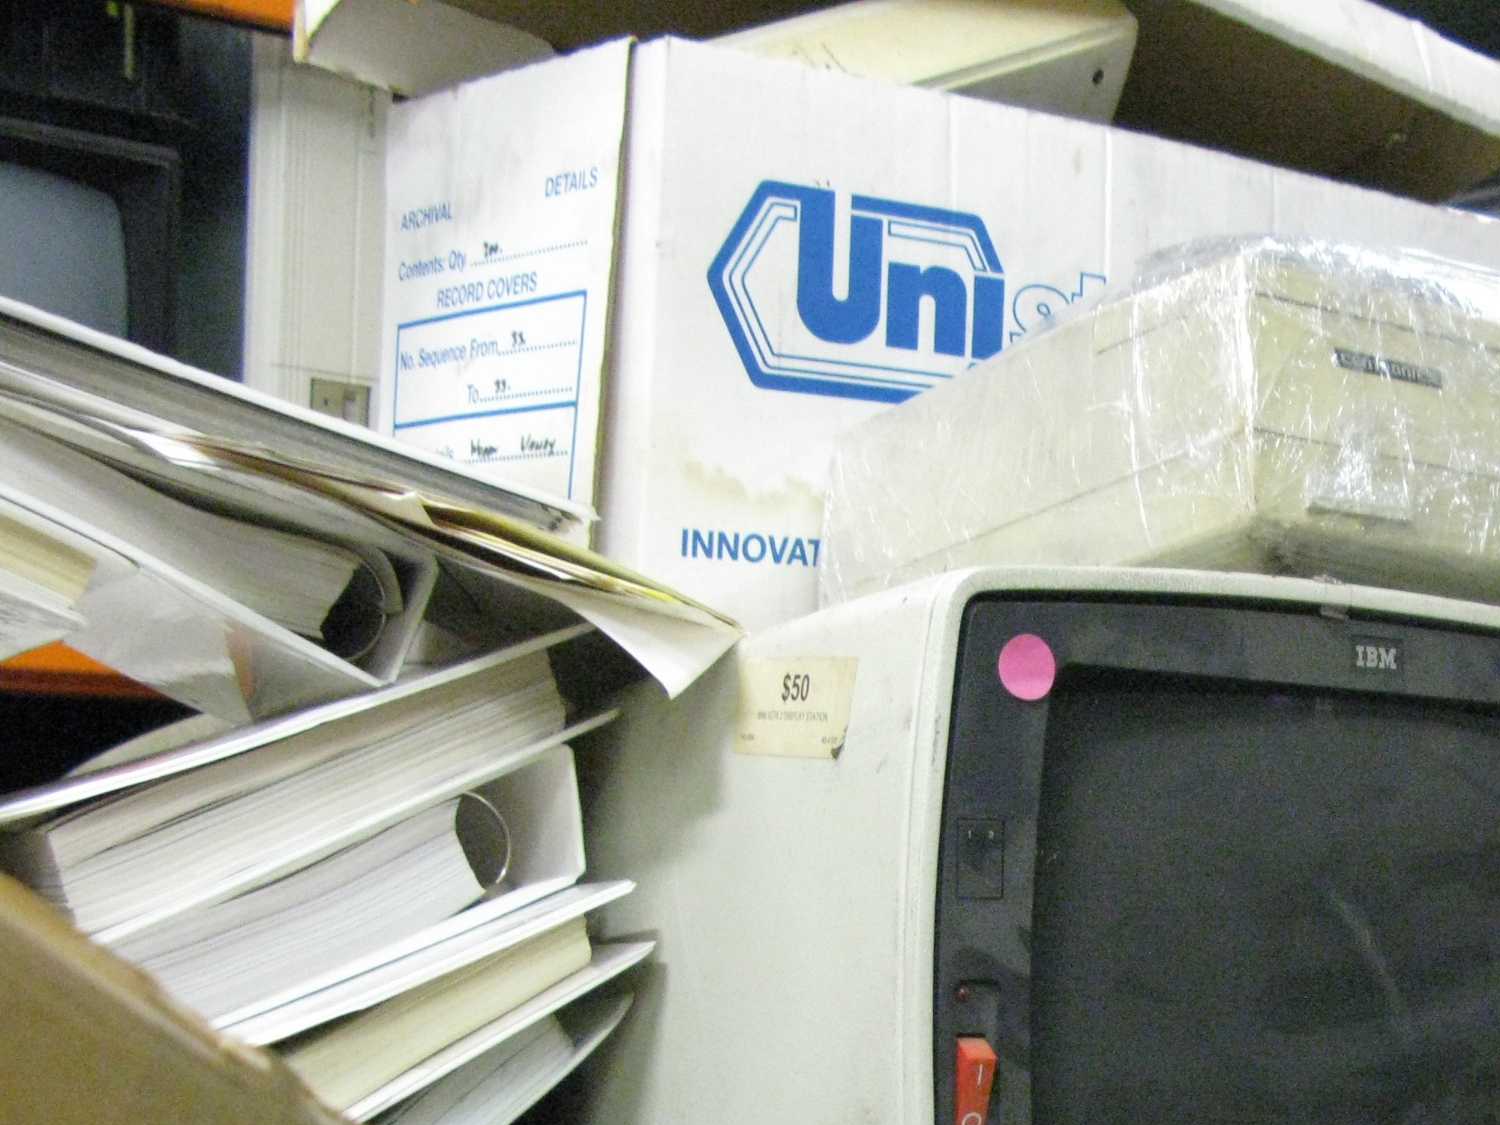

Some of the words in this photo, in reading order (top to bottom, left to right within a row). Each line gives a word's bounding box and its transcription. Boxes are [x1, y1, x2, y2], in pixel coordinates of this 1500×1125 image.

[544, 166, 599, 198] DETAILS
[400, 202, 453, 232] ARCHIVAL
[436, 281, 484, 309] RECORD
[487, 271, 538, 300] COVERS
[418, 343, 467, 369] Sequence
[469, 337, 499, 360] From
[467, 383, 480, 403] To
[1355, 644, 1397, 670] IBM
[781, 672, 810, 702] $50
